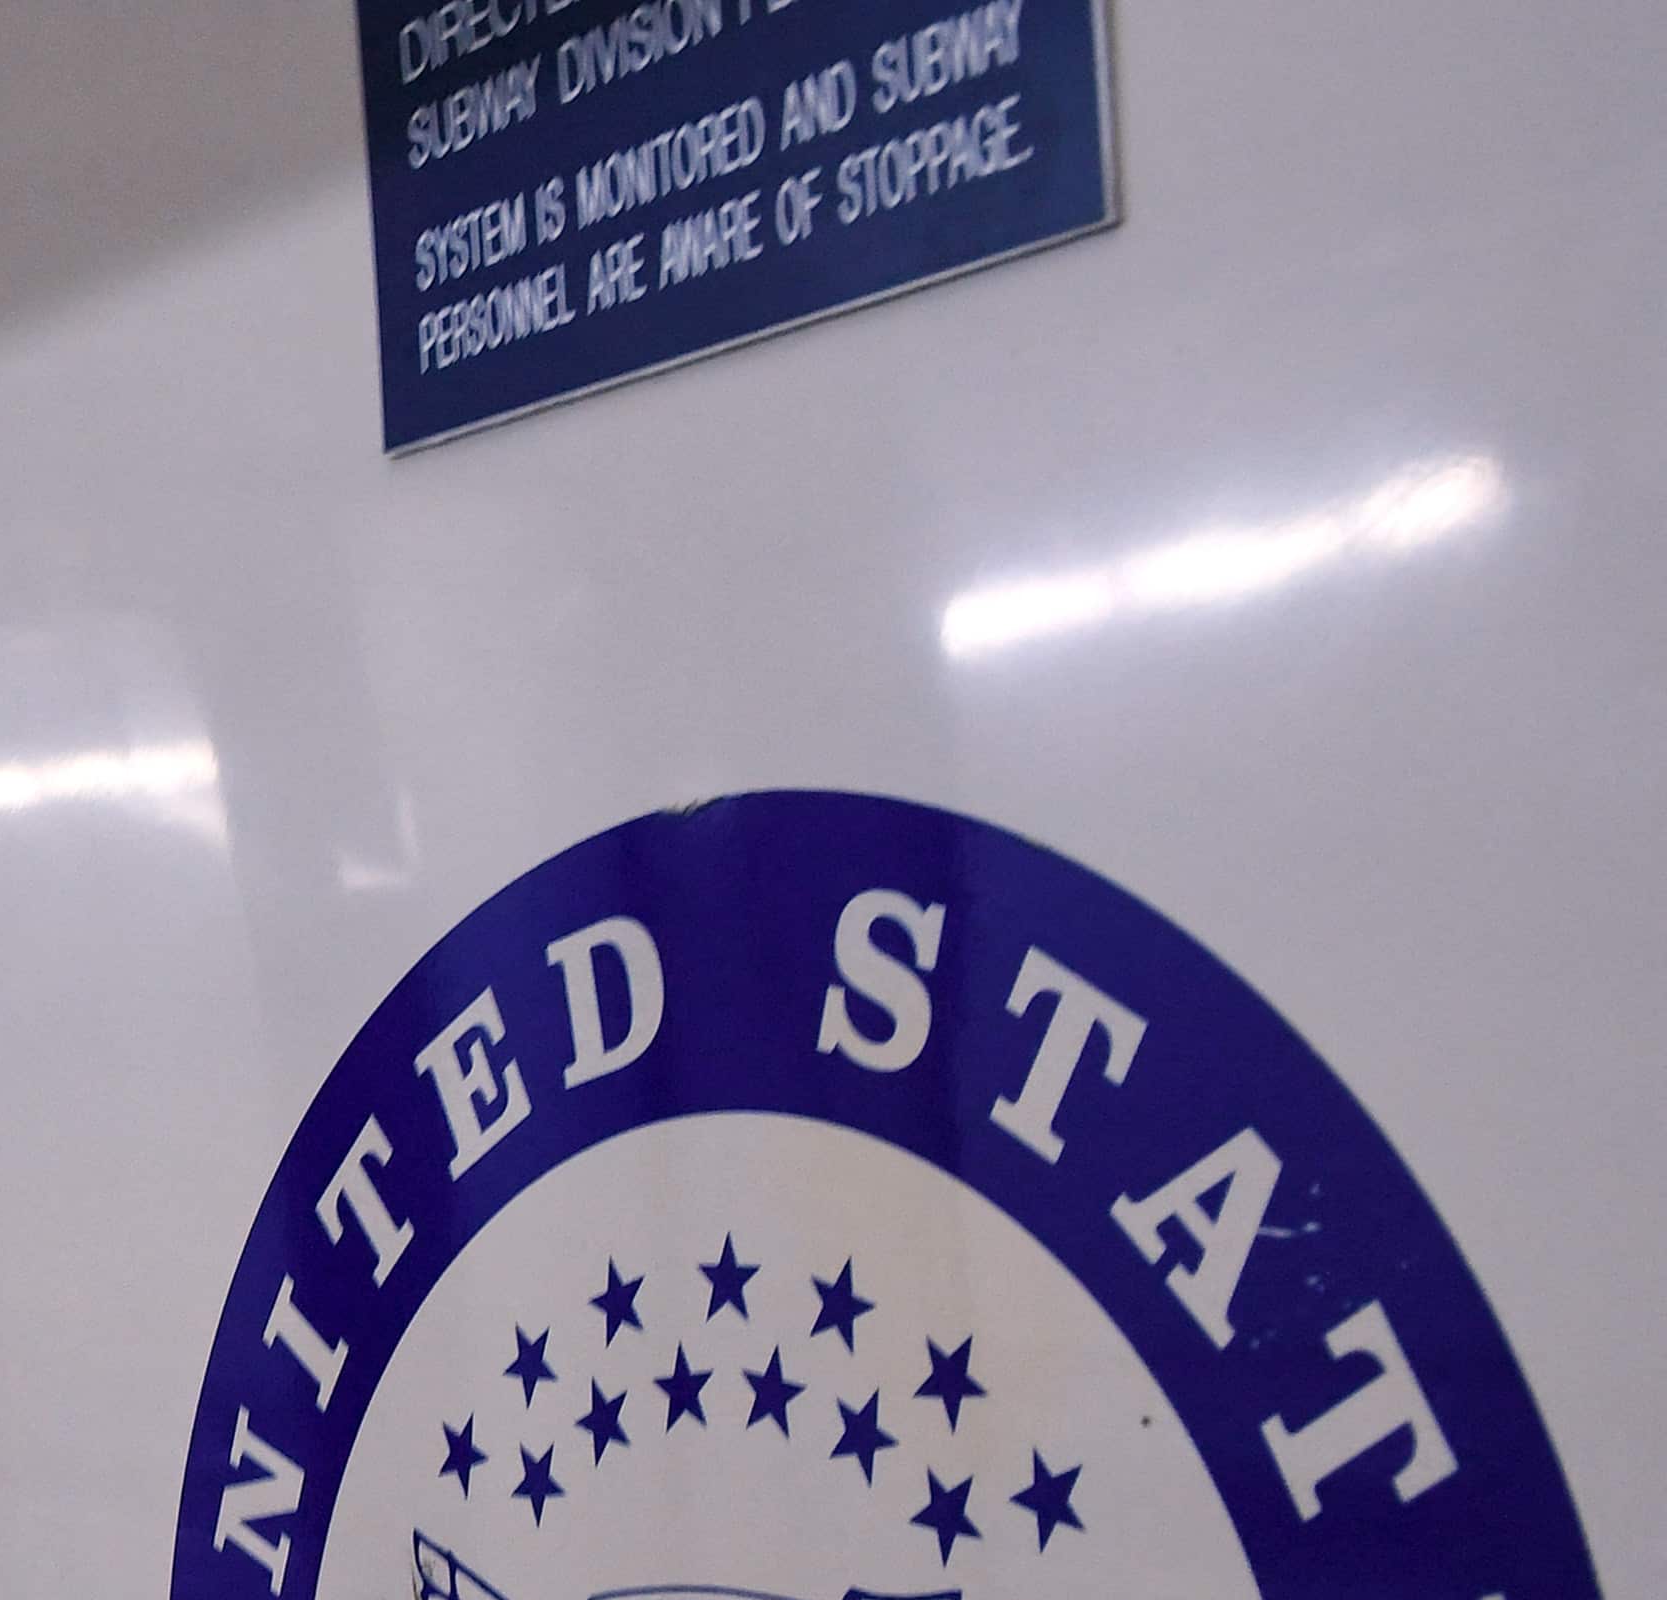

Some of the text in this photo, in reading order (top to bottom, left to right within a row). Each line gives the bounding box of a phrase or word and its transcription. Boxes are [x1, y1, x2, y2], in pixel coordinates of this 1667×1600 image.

[406, 0, 723, 170] SUBWAY DIVISION
[414, 0, 1023, 293] SYSTEM IS MONITORED AND SUBWAY
[418, 262, 577, 376] PERSONNEL
[586, 231, 650, 316] ARE
[658, 188, 766, 292] AWARE
[774, 164, 823, 246] OF
